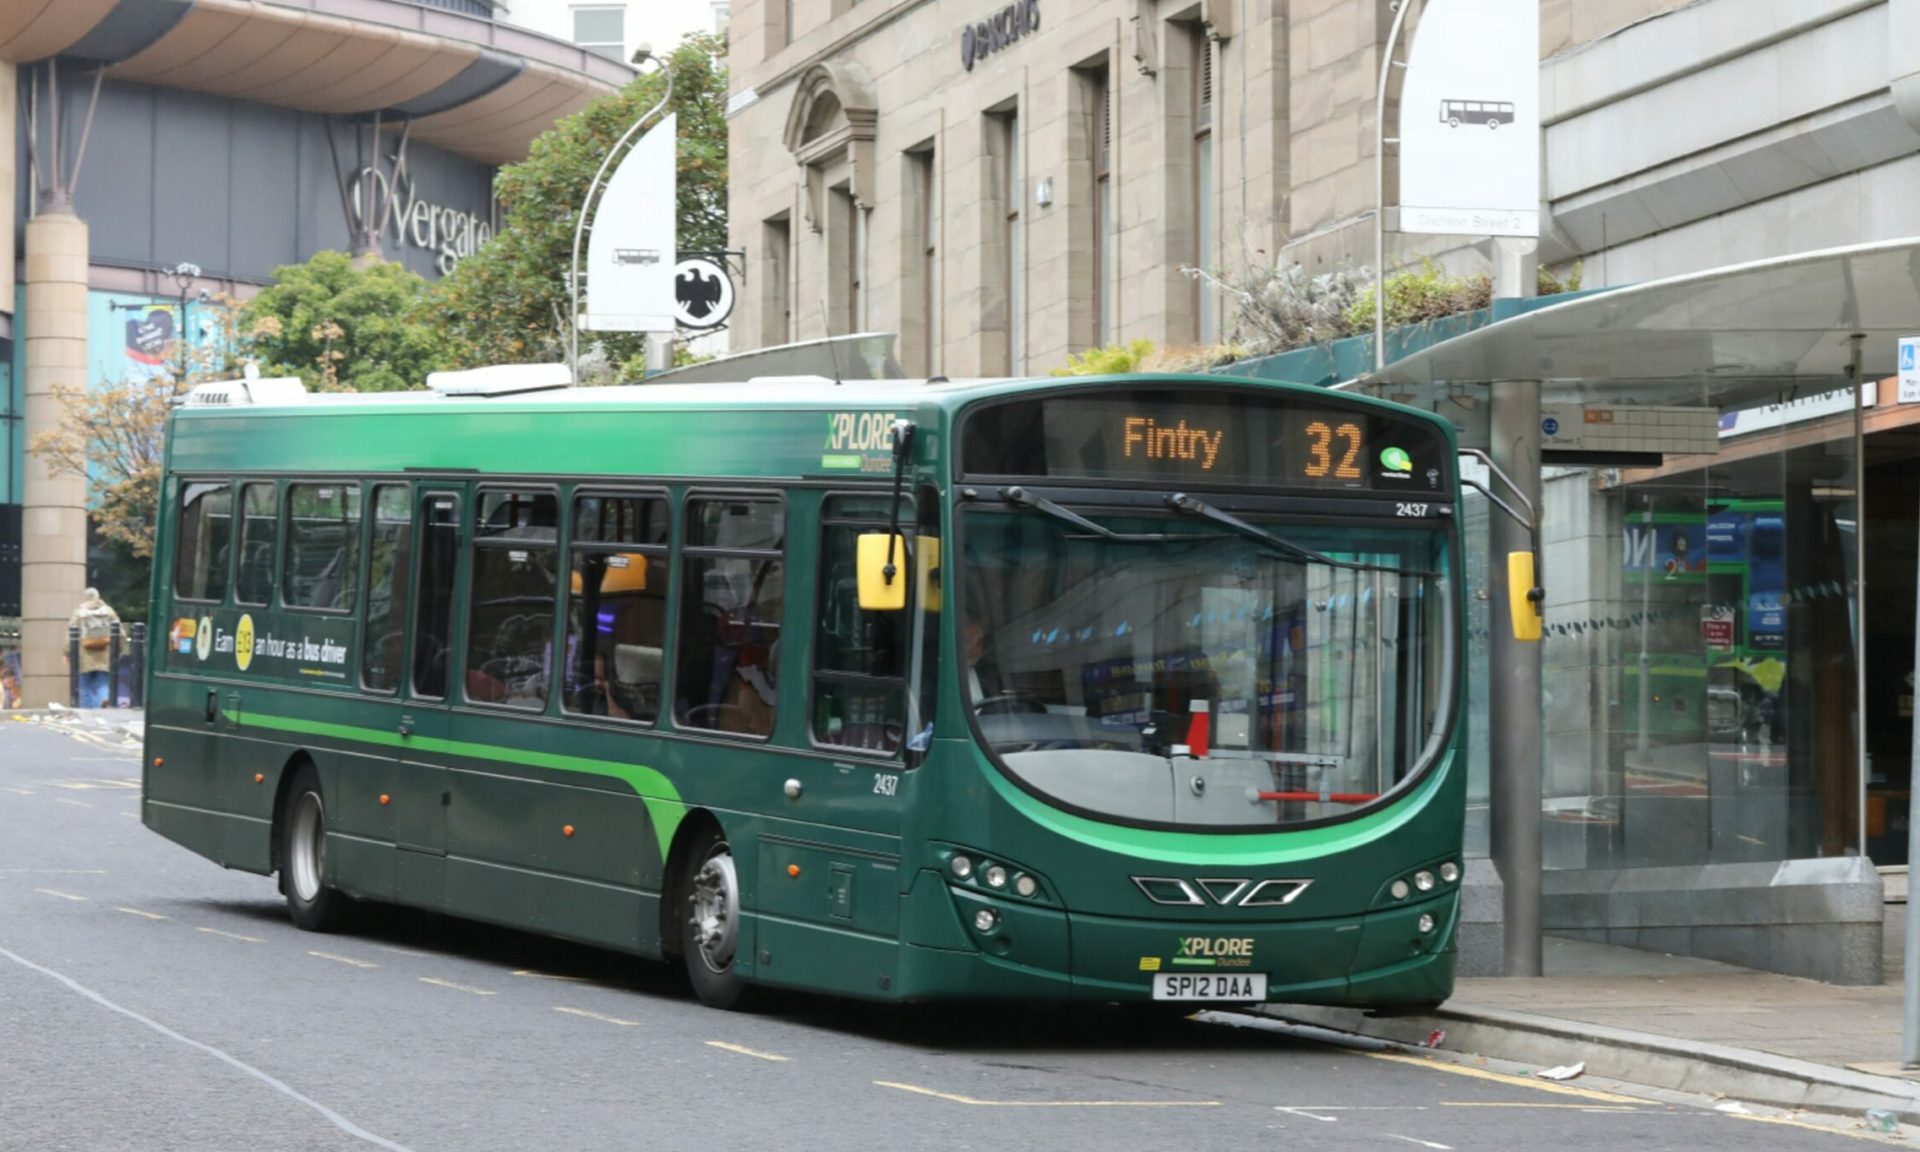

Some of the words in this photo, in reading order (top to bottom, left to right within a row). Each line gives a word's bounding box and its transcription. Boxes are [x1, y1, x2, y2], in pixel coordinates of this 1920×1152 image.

[1472, 215, 1509, 229] Street
[1513, 216, 1522, 230] 2
[824, 413, 896, 450] XPLORE
[1124, 417, 1222, 469] Fintry
[1305, 422, 1362, 478] 32
[1396, 503, 1428, 517] 2437
[255, 638, 265, 655] an
[267, 633, 285, 657] hour
[286, 642, 296, 659] as
[297, 643, 302, 660] a
[304, 637, 320, 662] bus
[321, 638, 347, 664] driver
[873, 773, 899, 796] 2437
[1176, 937, 1255, 956] XPLORE
[1166, 977, 1210, 997] SP12
[1216, 977, 1253, 997] DAA
